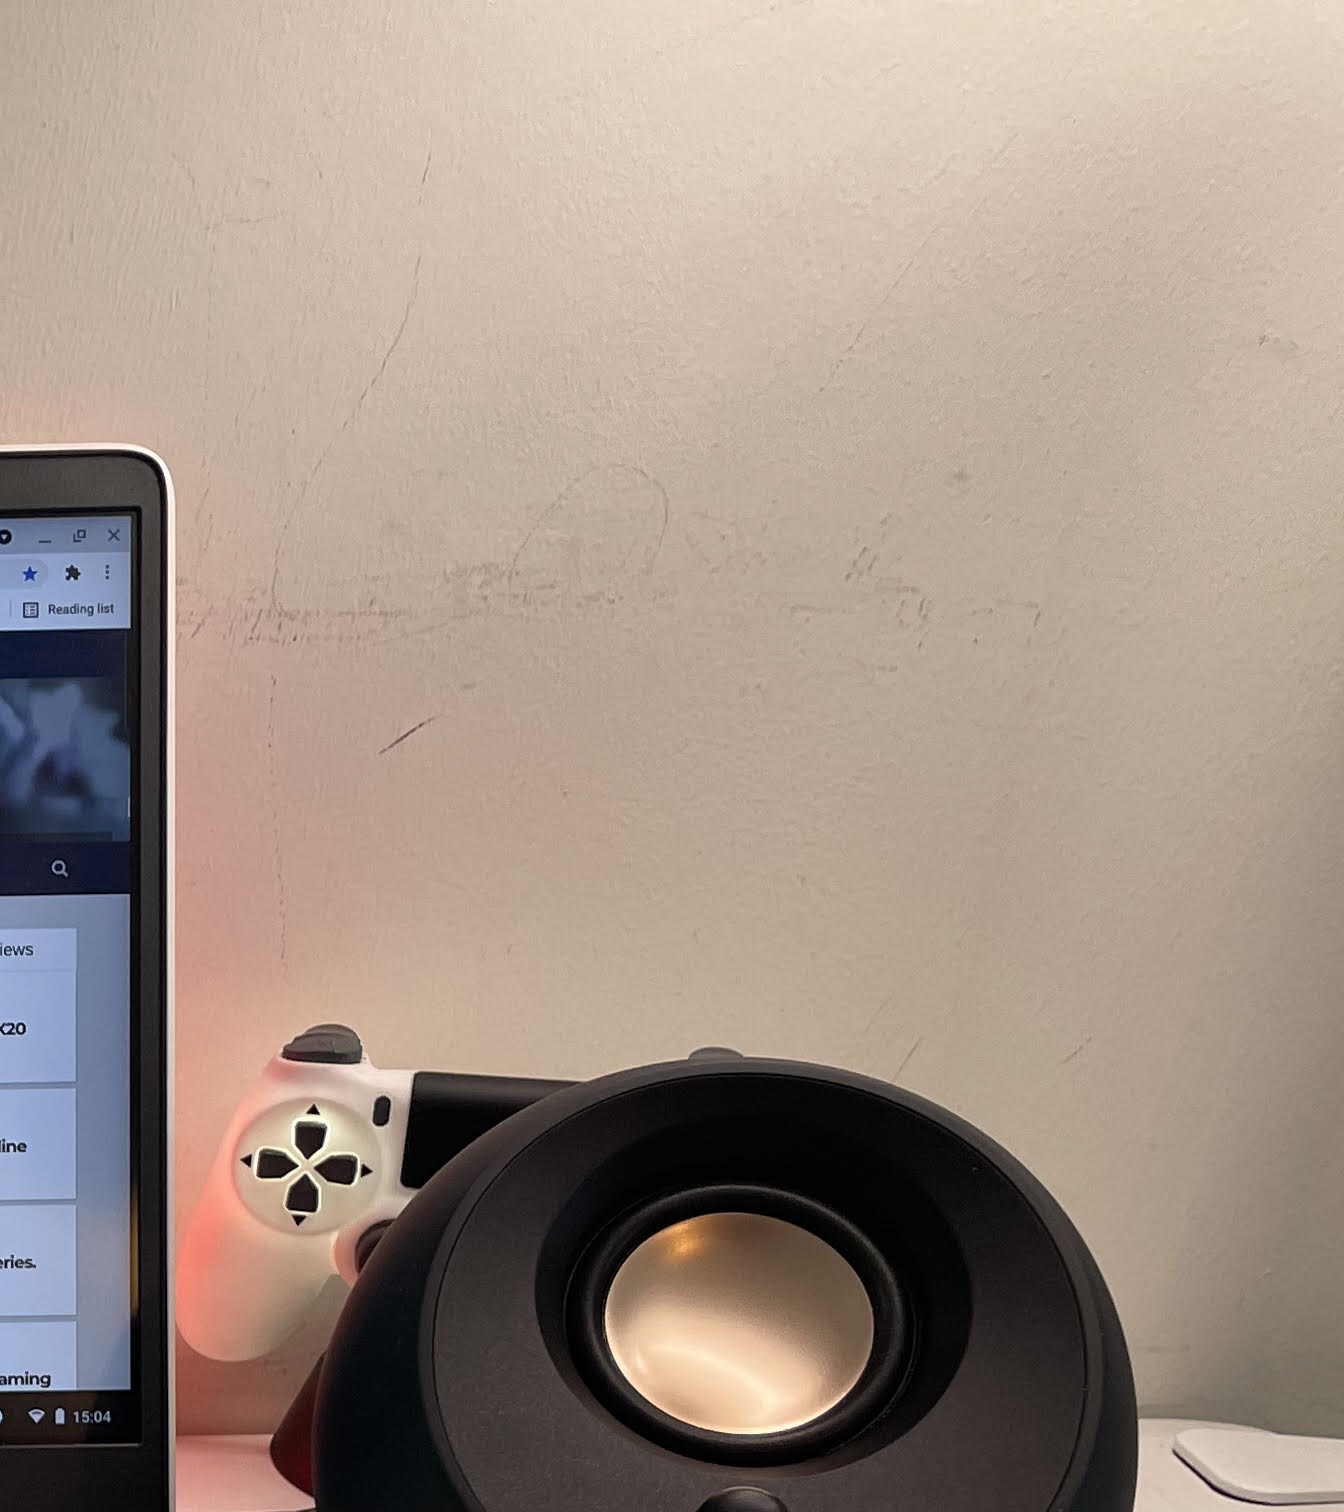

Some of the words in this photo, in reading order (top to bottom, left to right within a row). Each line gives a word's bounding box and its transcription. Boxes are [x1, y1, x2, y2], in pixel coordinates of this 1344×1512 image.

[48, 604, 94, 617] Reading
[97, 603, 114, 614] list
[73, 1411, 111, 1424] 15:04
